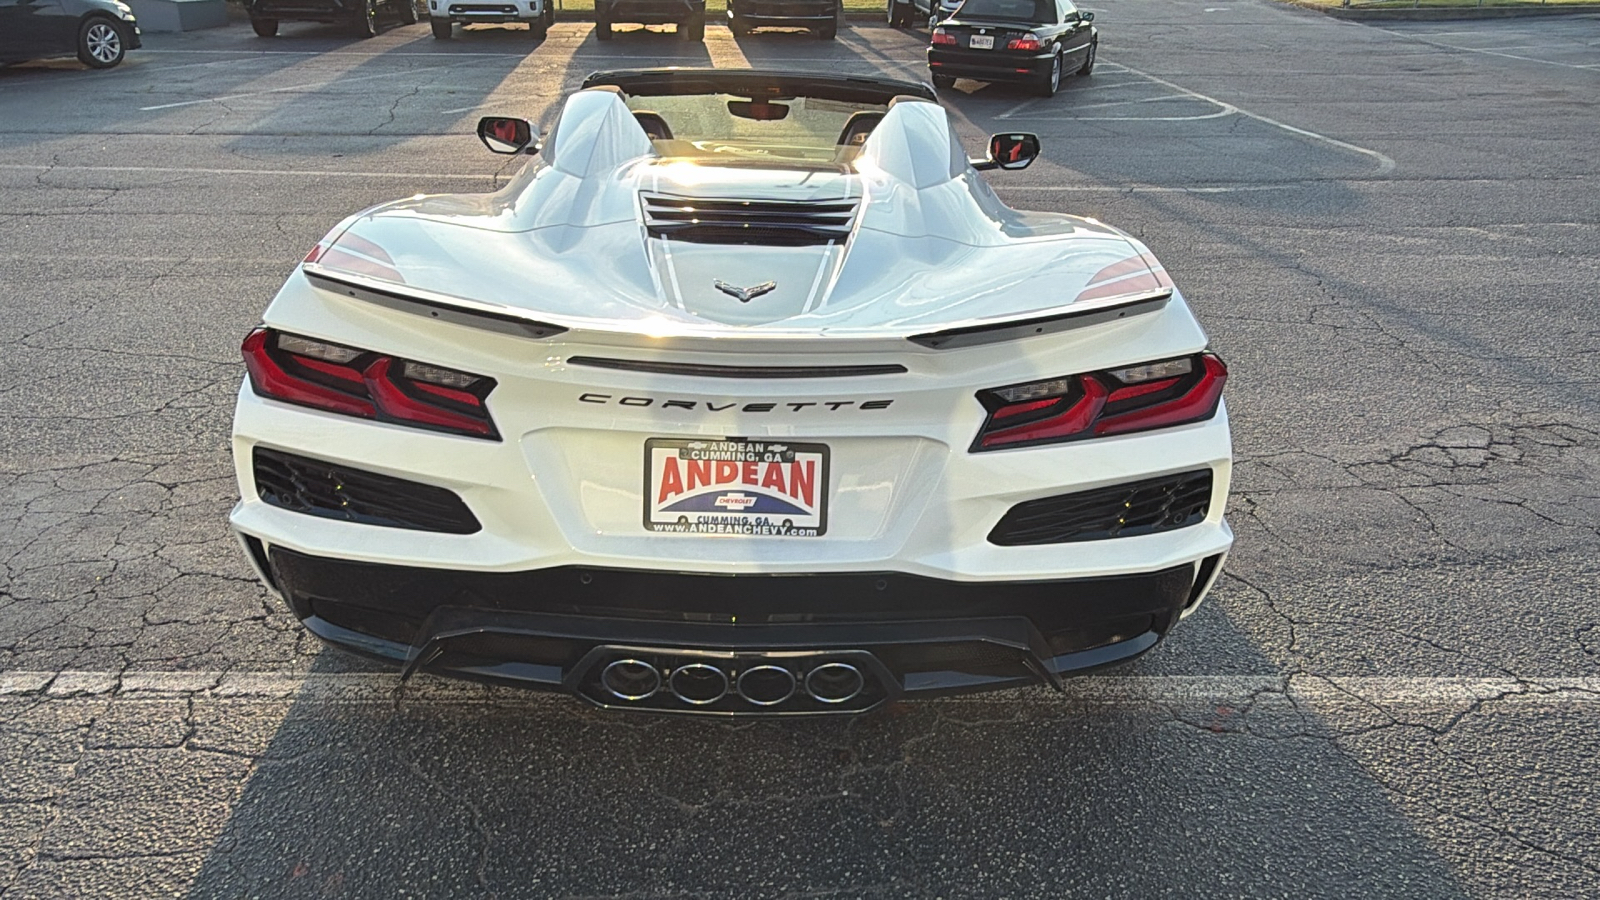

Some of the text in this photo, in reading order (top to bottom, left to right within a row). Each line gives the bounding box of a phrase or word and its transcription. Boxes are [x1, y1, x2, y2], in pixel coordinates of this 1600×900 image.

[578, 393, 894, 413] CORVETTE
[710, 442, 764, 453] ANDEAN
[691, 452, 782, 463] CUMMING, GA
[658, 457, 815, 508] ANDEAN
[697, 516, 753, 526] CUMMING,
[653, 523, 818, 537] www.ANDEANCHEVY.com
